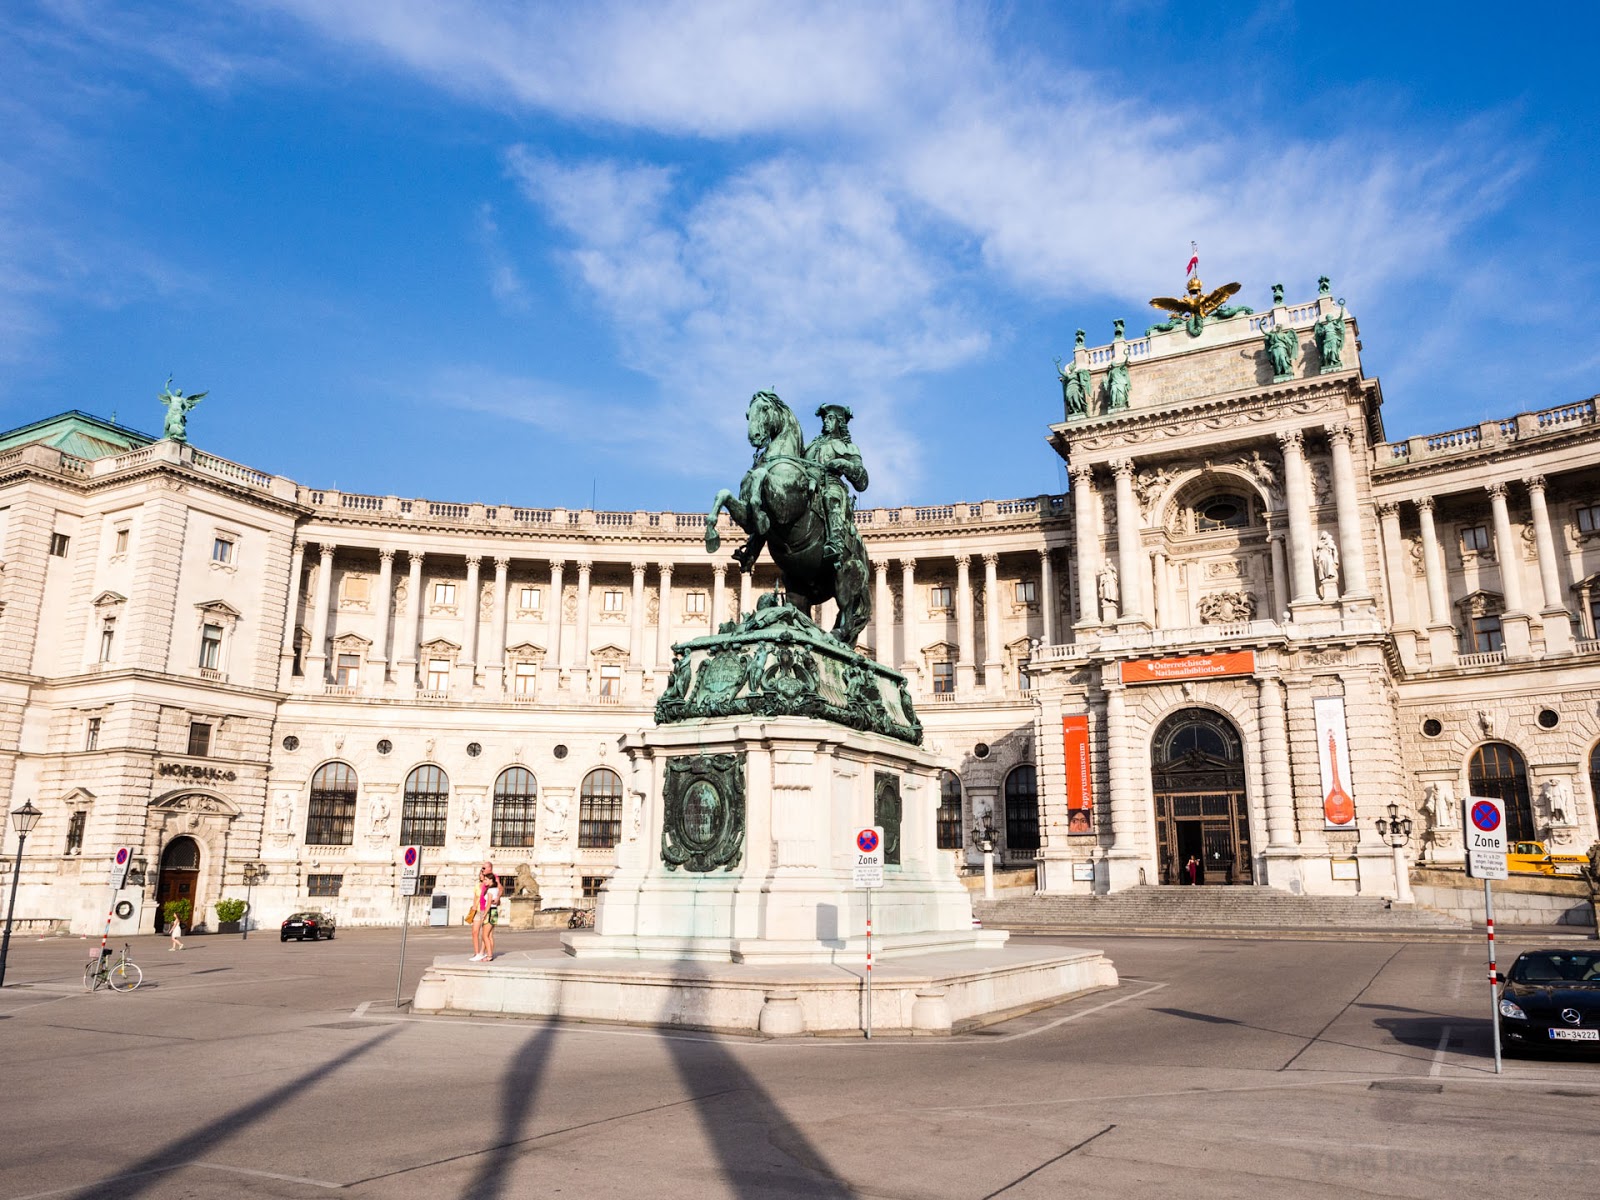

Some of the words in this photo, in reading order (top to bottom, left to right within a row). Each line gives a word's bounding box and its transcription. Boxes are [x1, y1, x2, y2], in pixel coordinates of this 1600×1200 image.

[1154, 659, 1212, 670] Österreichische
[1155, 665, 1226, 677] Nationalbibliothek
[159, 762, 237, 782] HOFBURG
[1080, 742, 1089, 811] Papyrusmuseum
[1474, 833, 1500, 848] Zone
[858, 854, 878, 865] Zone
[1555, 1030, 1597, 1039] WD-34222
